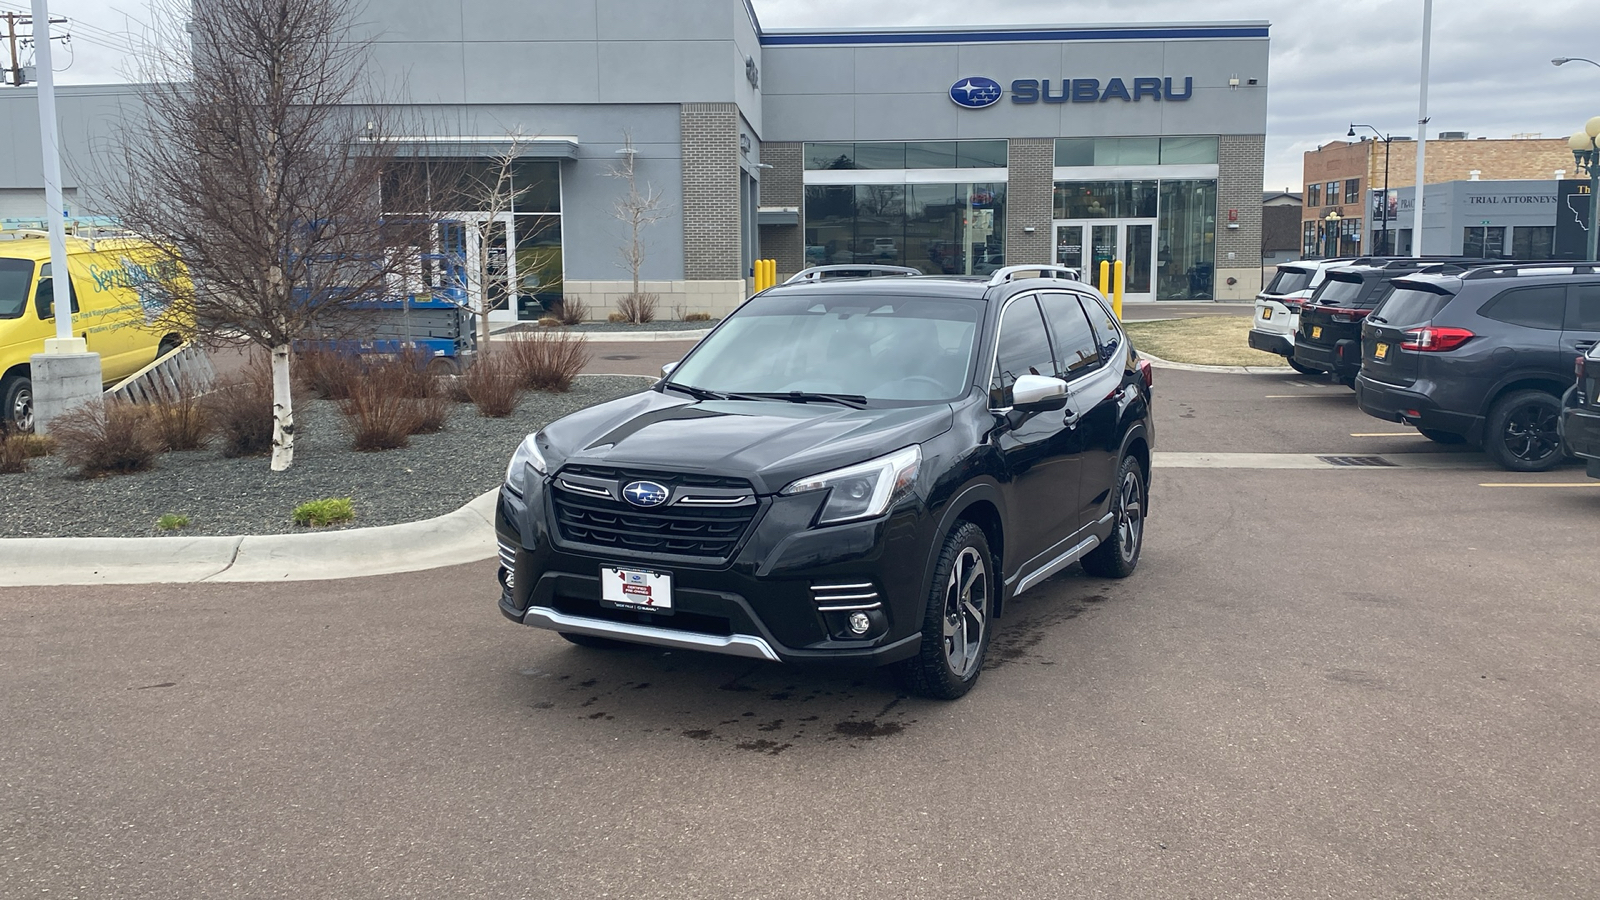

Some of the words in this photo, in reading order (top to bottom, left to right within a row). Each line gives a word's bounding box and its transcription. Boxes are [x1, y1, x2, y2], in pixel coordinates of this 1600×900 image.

[1011, 77, 1193, 104] SUBARU
[1400, 197, 1426, 209] PRACE
[1469, 196, 1499, 204] TRIAL
[1501, 195, 1558, 204] ATTORNEYS
